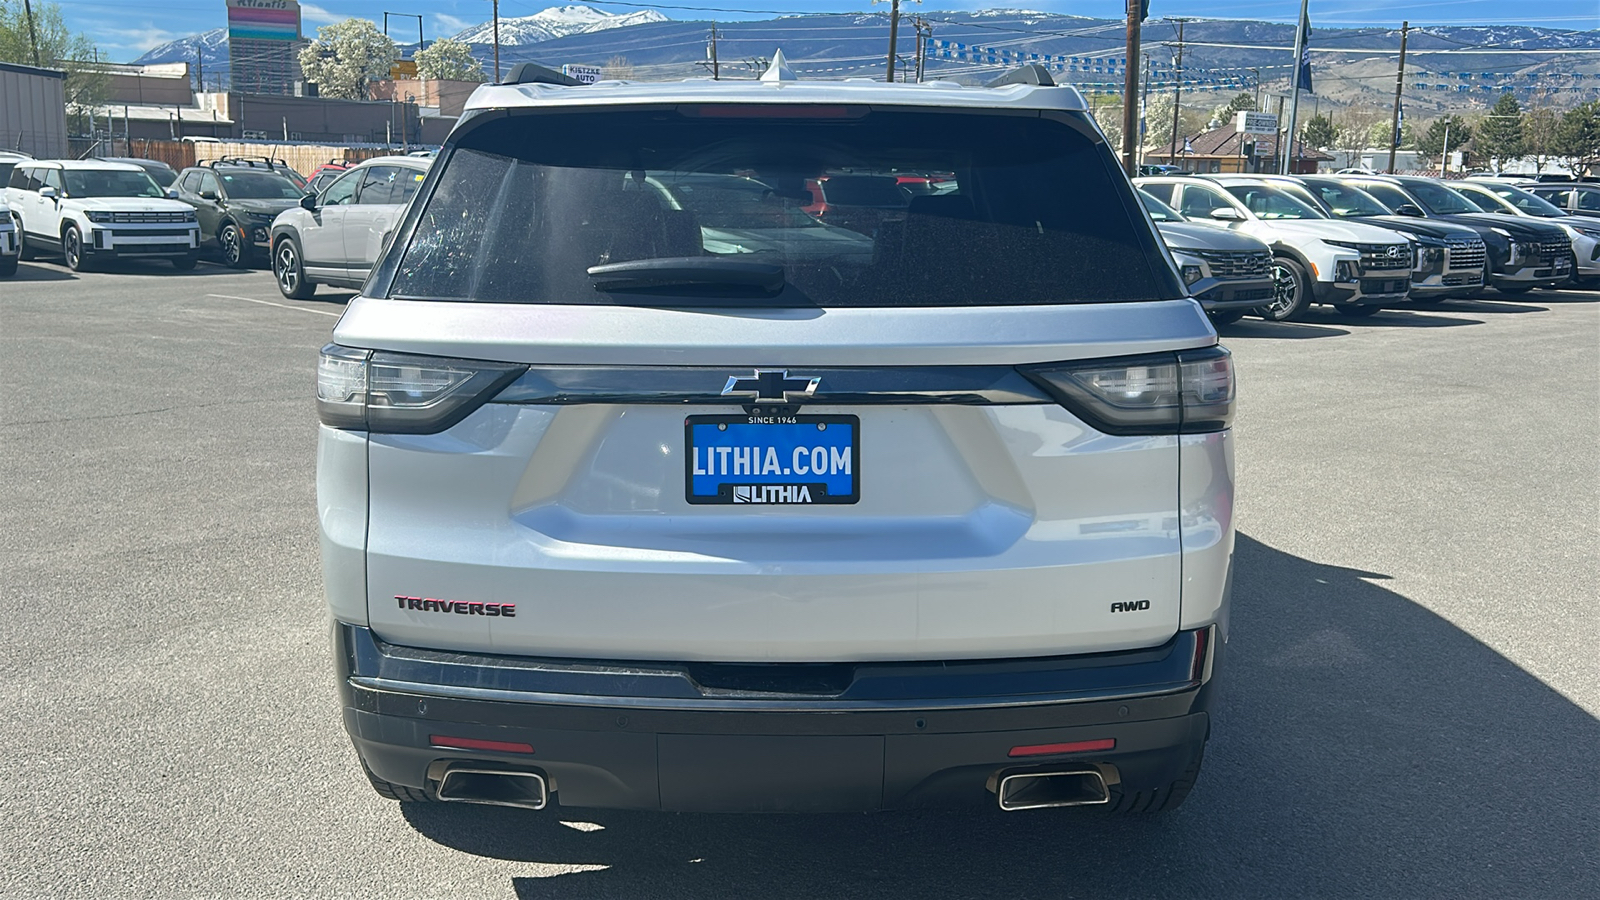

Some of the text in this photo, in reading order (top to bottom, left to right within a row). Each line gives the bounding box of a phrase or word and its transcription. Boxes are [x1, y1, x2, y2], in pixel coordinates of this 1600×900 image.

[570, 66, 600, 75] KIETZKE
[575, 74, 595, 82] AUTO
[748, 416, 797, 424] SINCE 1946
[693, 446, 852, 475] LITHIA.COM
[751, 486, 812, 503] LITHIA
[394, 595, 516, 617] TRAVERSE
[1110, 600, 1150, 613] AWD
